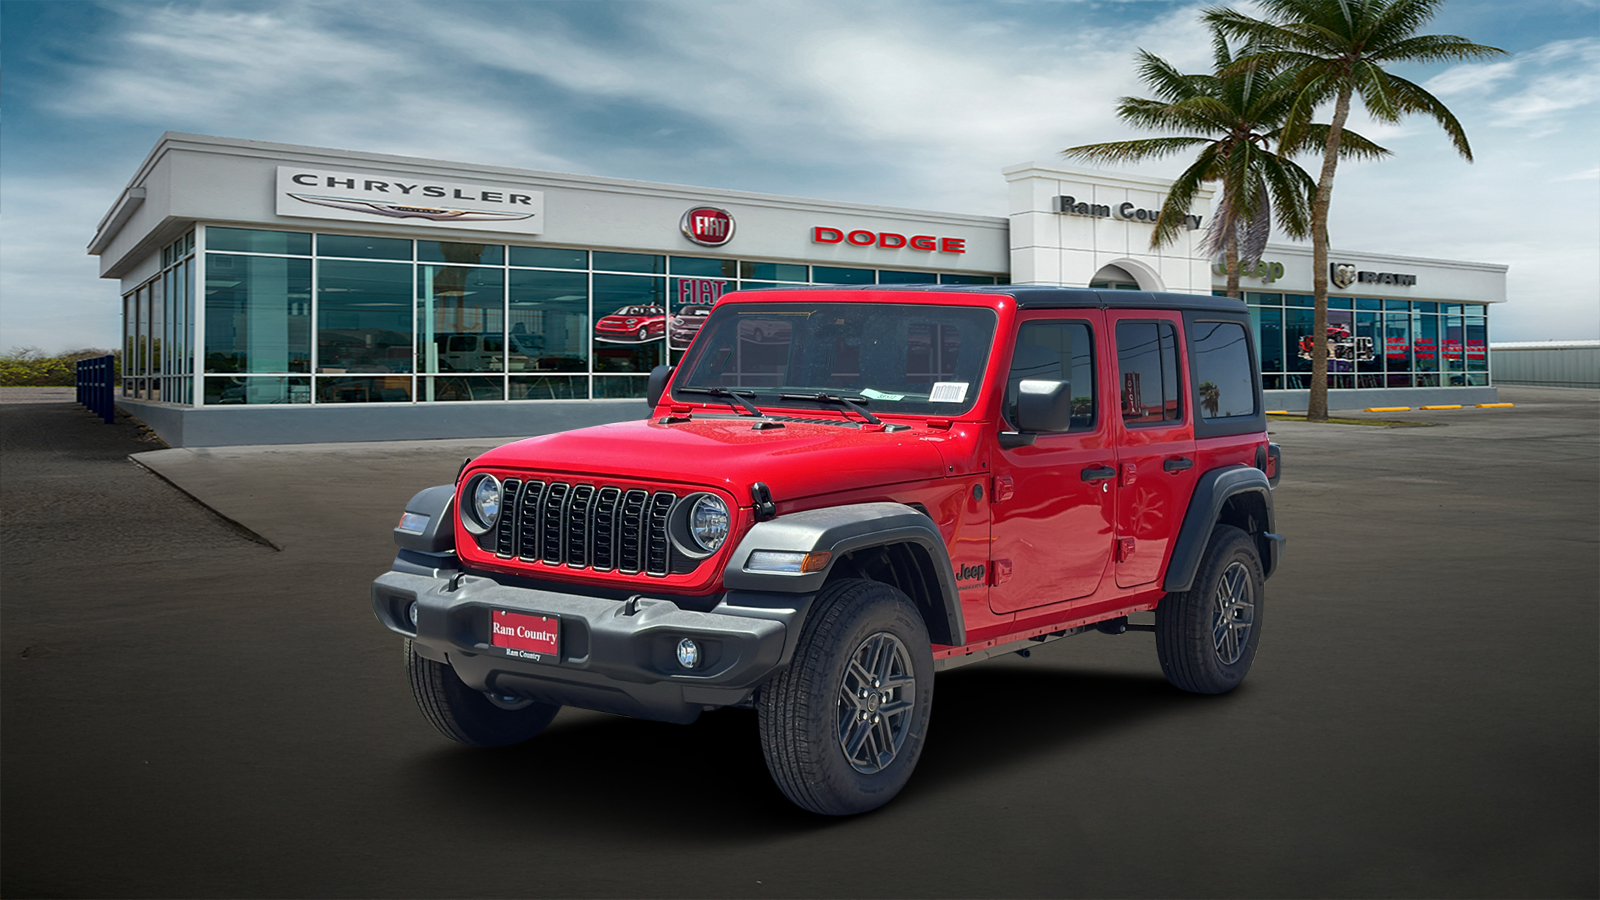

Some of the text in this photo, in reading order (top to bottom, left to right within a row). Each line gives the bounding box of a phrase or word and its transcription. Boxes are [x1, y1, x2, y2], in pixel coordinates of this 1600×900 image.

[292, 174, 532, 205] CHRYSLER
[1060, 195, 1202, 230] Ram Coury
[695, 215, 728, 237] FIAT
[813, 226, 966, 254] DODGE
[1360, 271, 1416, 286] RAM
[678, 278, 727, 304] FIAT
[956, 563, 985, 581] Jeep
[493, 622, 557, 644] Ram Country
[506, 648, 540, 661] Ram Country
